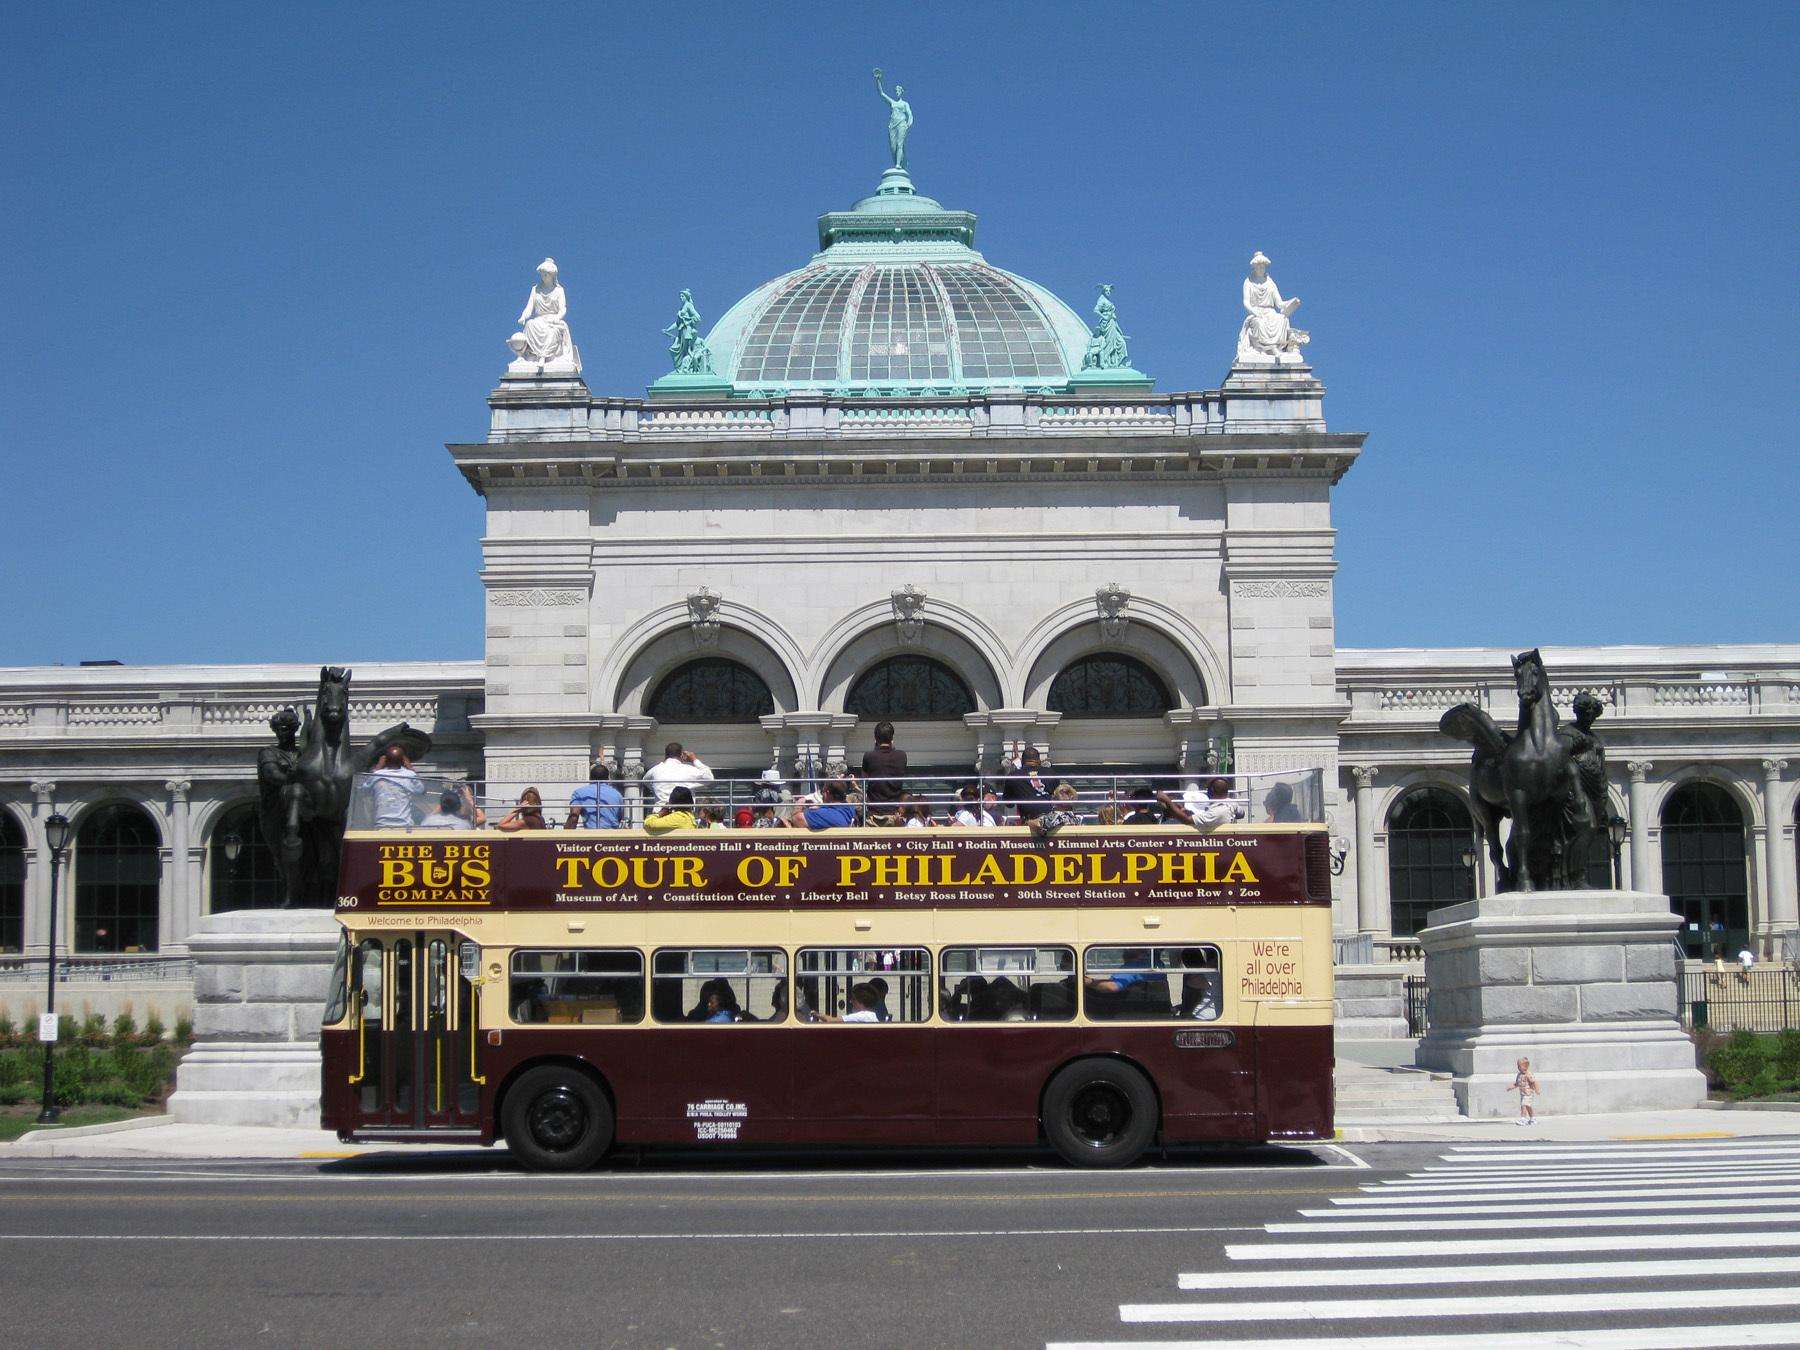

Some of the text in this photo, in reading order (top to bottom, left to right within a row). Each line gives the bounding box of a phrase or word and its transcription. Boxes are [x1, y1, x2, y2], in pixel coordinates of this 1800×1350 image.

[380, 845, 491, 859] THE BIG
[555, 838, 1258, 853] Visitor Center Independence Hall Reading Terminal Market City Hall Rodin Museum Kimmel Arts Center Franklin Court
[378, 859, 491, 888] BUS
[556, 851, 1260, 888] TOUR OF PHILADELPHIA
[337, 896, 358, 907] 360
[378, 889, 491, 900] COMPANY
[555, 889, 1261, 902] Museum of Art Constitution Center Liberty Bell Betsy Ross House 30th Street Station Antique Row Zoo
[368, 916, 483, 926] Welcome to Philadelphia
[1252, 941, 1289, 956] We're
[1247, 960, 1296, 975] all over
[1241, 977, 1302, 998] Philadelphia
